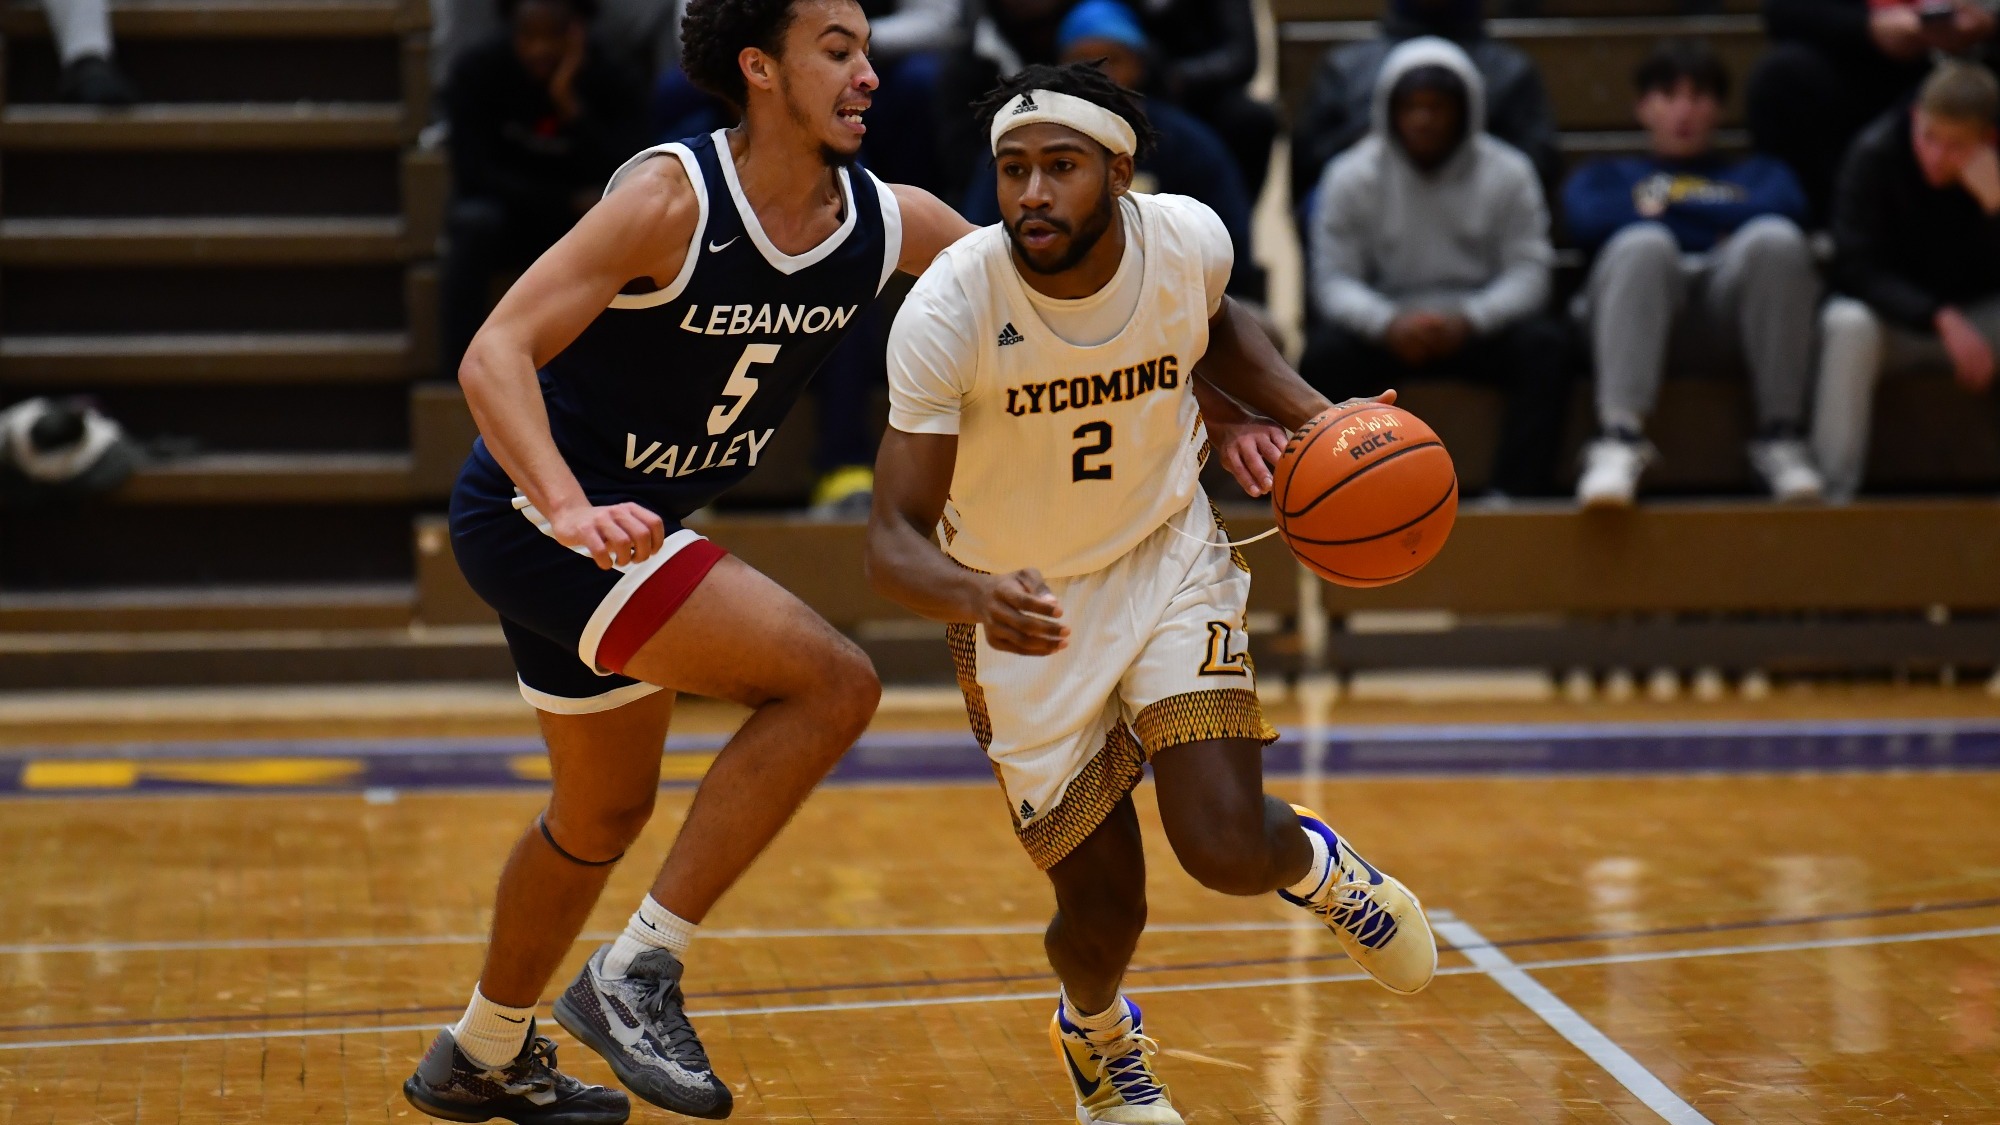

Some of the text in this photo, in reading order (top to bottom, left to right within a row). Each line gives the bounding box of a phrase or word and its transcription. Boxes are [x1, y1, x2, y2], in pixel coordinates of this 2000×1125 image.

[1012, 104, 1039, 115] adidas
[679, 303, 858, 335] LEBANON
[997, 335, 1024, 347] adidas
[706, 343, 782, 435] 5
[1006, 354, 1179, 417] LYCOMING
[625, 428, 775, 478] VALLEY
[1071, 420, 1114, 483] 2
[1349, 430, 1398, 460] ROCK
[1198, 621, 1247, 677] L
